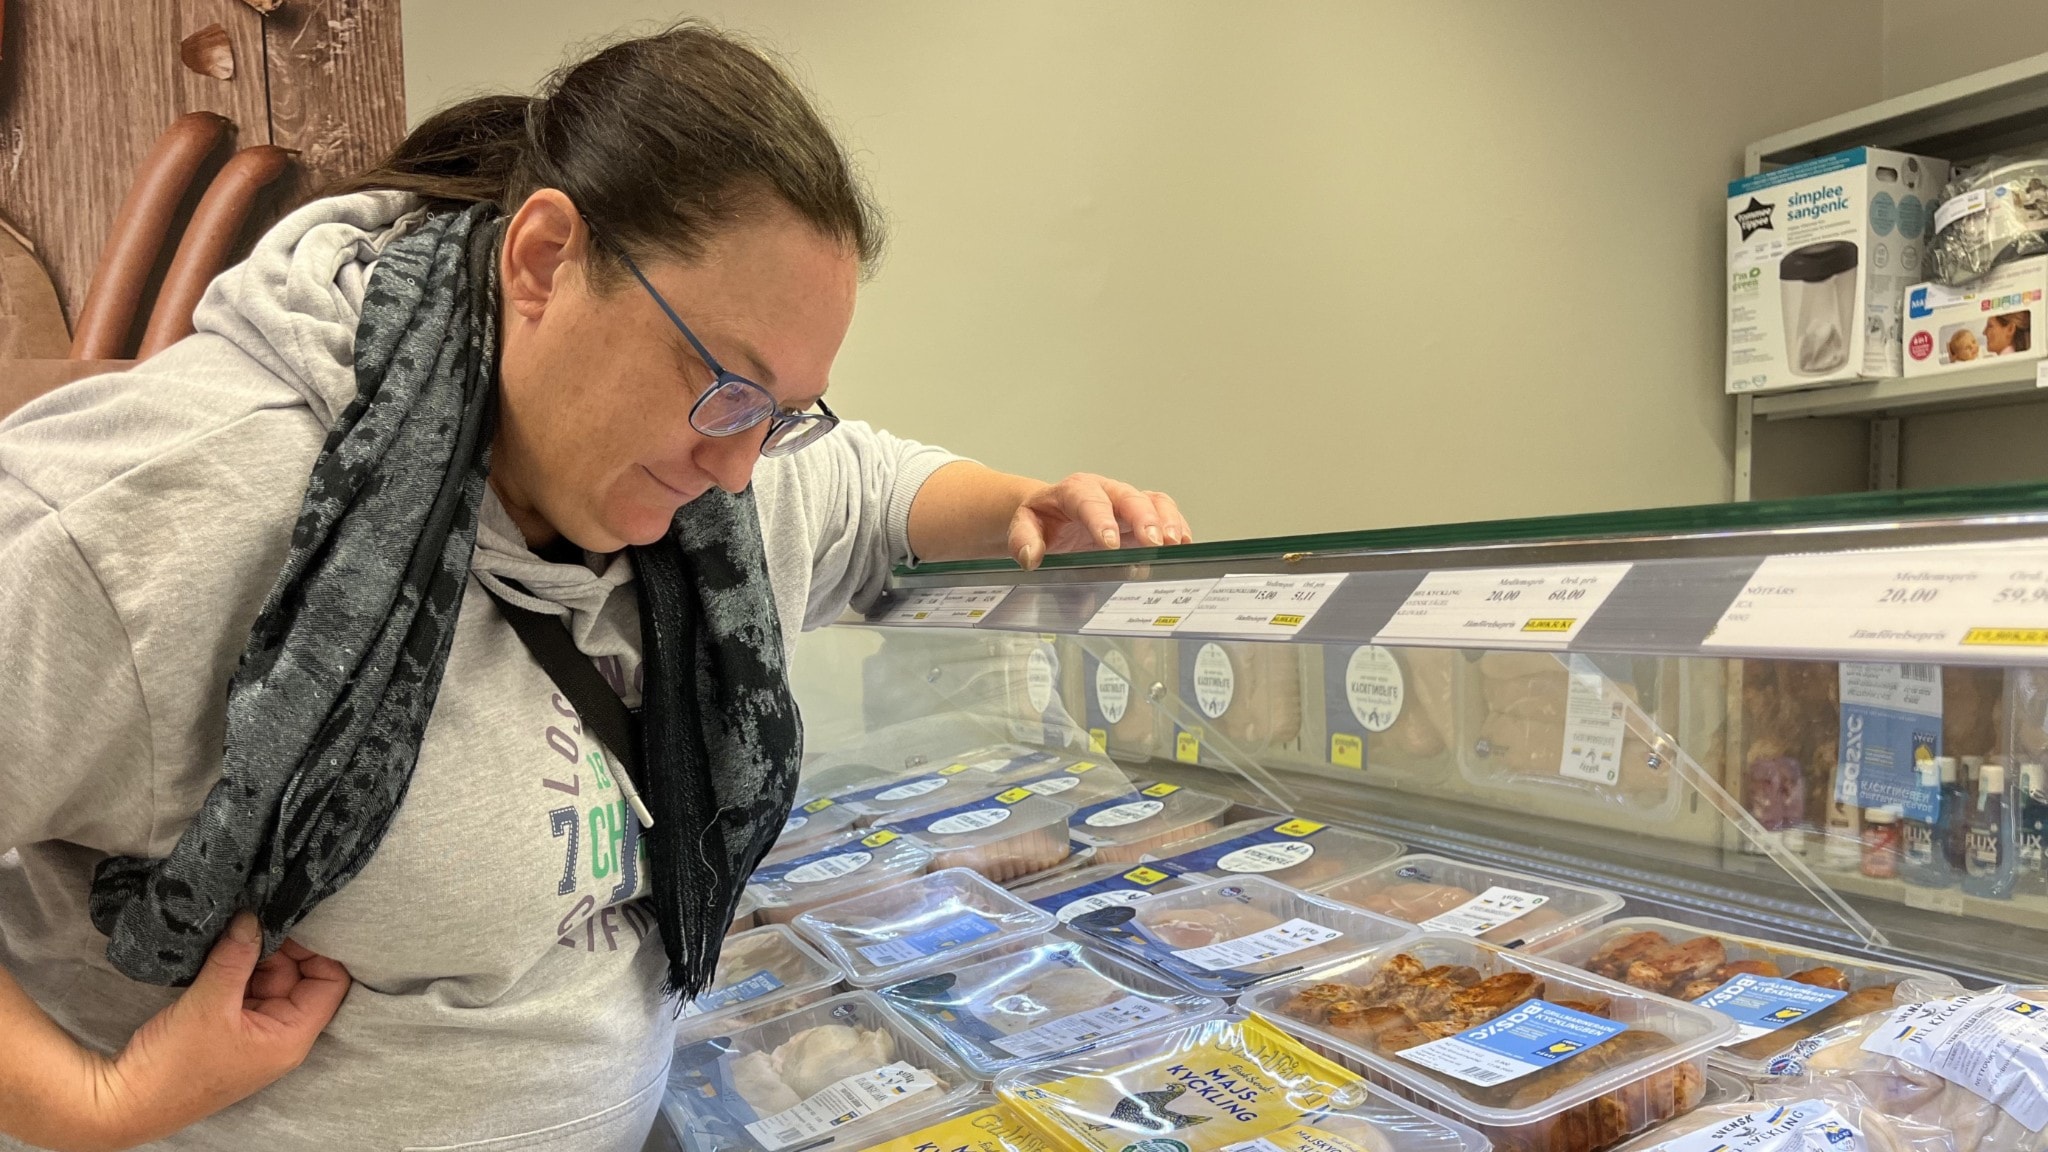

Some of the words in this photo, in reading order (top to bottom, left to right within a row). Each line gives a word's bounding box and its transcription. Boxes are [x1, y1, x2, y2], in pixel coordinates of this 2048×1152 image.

[1787, 186, 1843, 207] simplee
[1787, 198, 1849, 221] sangenic
[1485, 589, 1521, 602] 20,00
[1548, 588, 1586, 601] 60,00
[1878, 587, 1939, 604] 20,00
[1965, 833, 1998, 850] FLUX
[1751, 985, 1826, 1003] KYCKLINGBEN
[1534, 1013, 1606, 1037] KYCKLINGBEN
[1543, 1008, 1616, 1034] GRILLMARINERADE
[1908, 1024, 1932, 1044] HEL
[1928, 995, 1975, 1027] KYCKLIN
[1166, 1063, 1259, 1123] KYCKLING
[1204, 1067, 1259, 1104] MAJS-
[1711, 1113, 1754, 1140] SVENSK
[1743, 1109, 1804, 1147] KYCKLING
